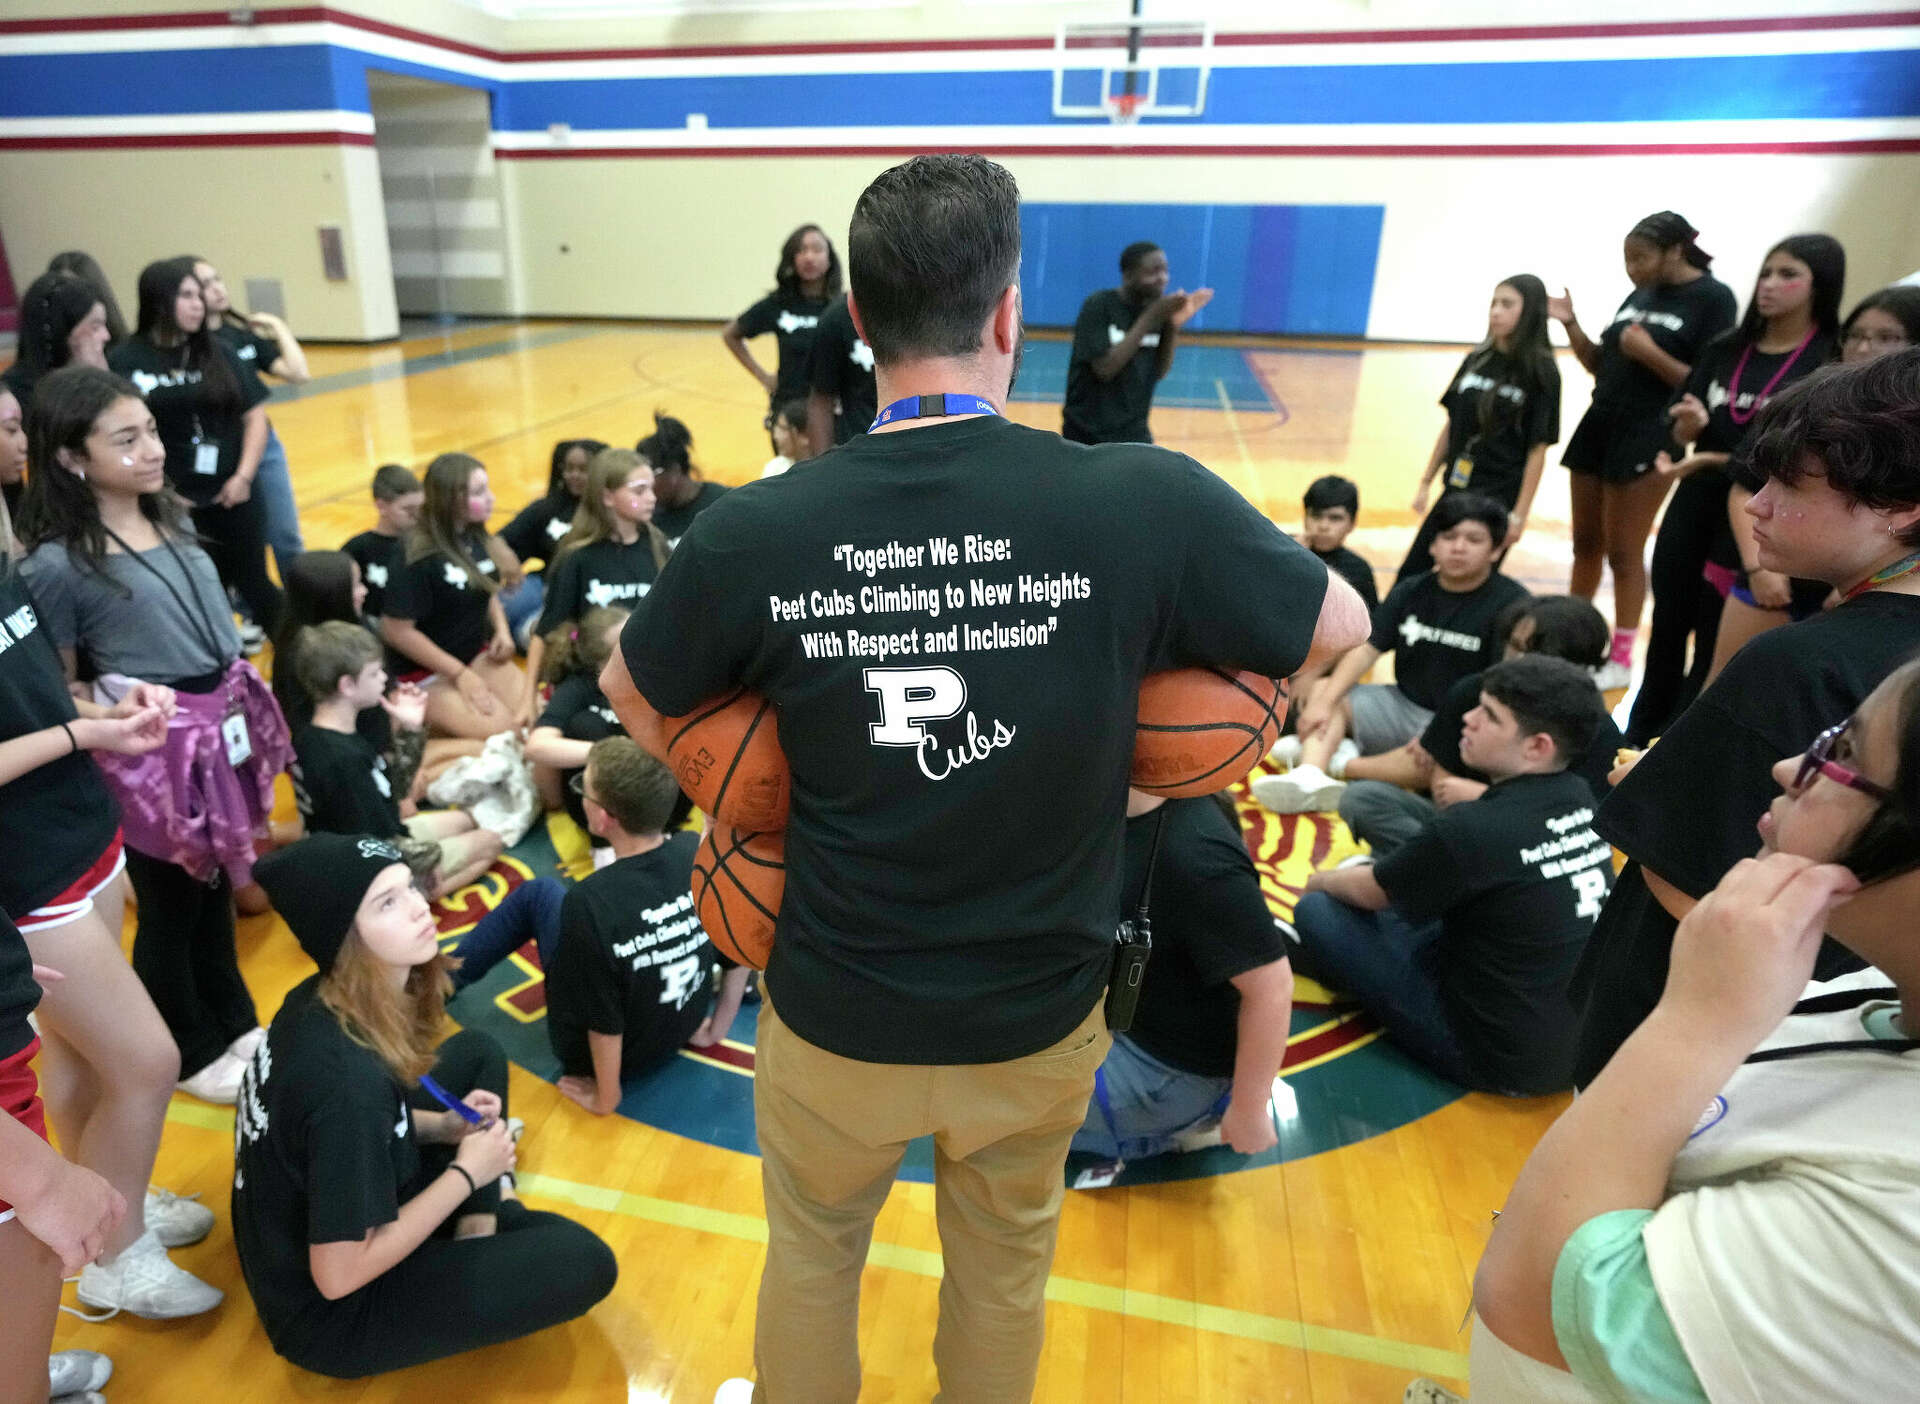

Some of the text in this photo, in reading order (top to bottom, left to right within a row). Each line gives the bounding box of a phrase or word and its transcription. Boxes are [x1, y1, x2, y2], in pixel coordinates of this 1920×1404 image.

[833, 534, 1012, 577] “Together We Rise:
[770, 571, 1091, 622] Peet Cubs Climbing to New Heights
[800, 616, 1058, 662] With Respect and Inclusion”
[863, 665, 968, 748] P
[917, 711, 1016, 781] Cubs
